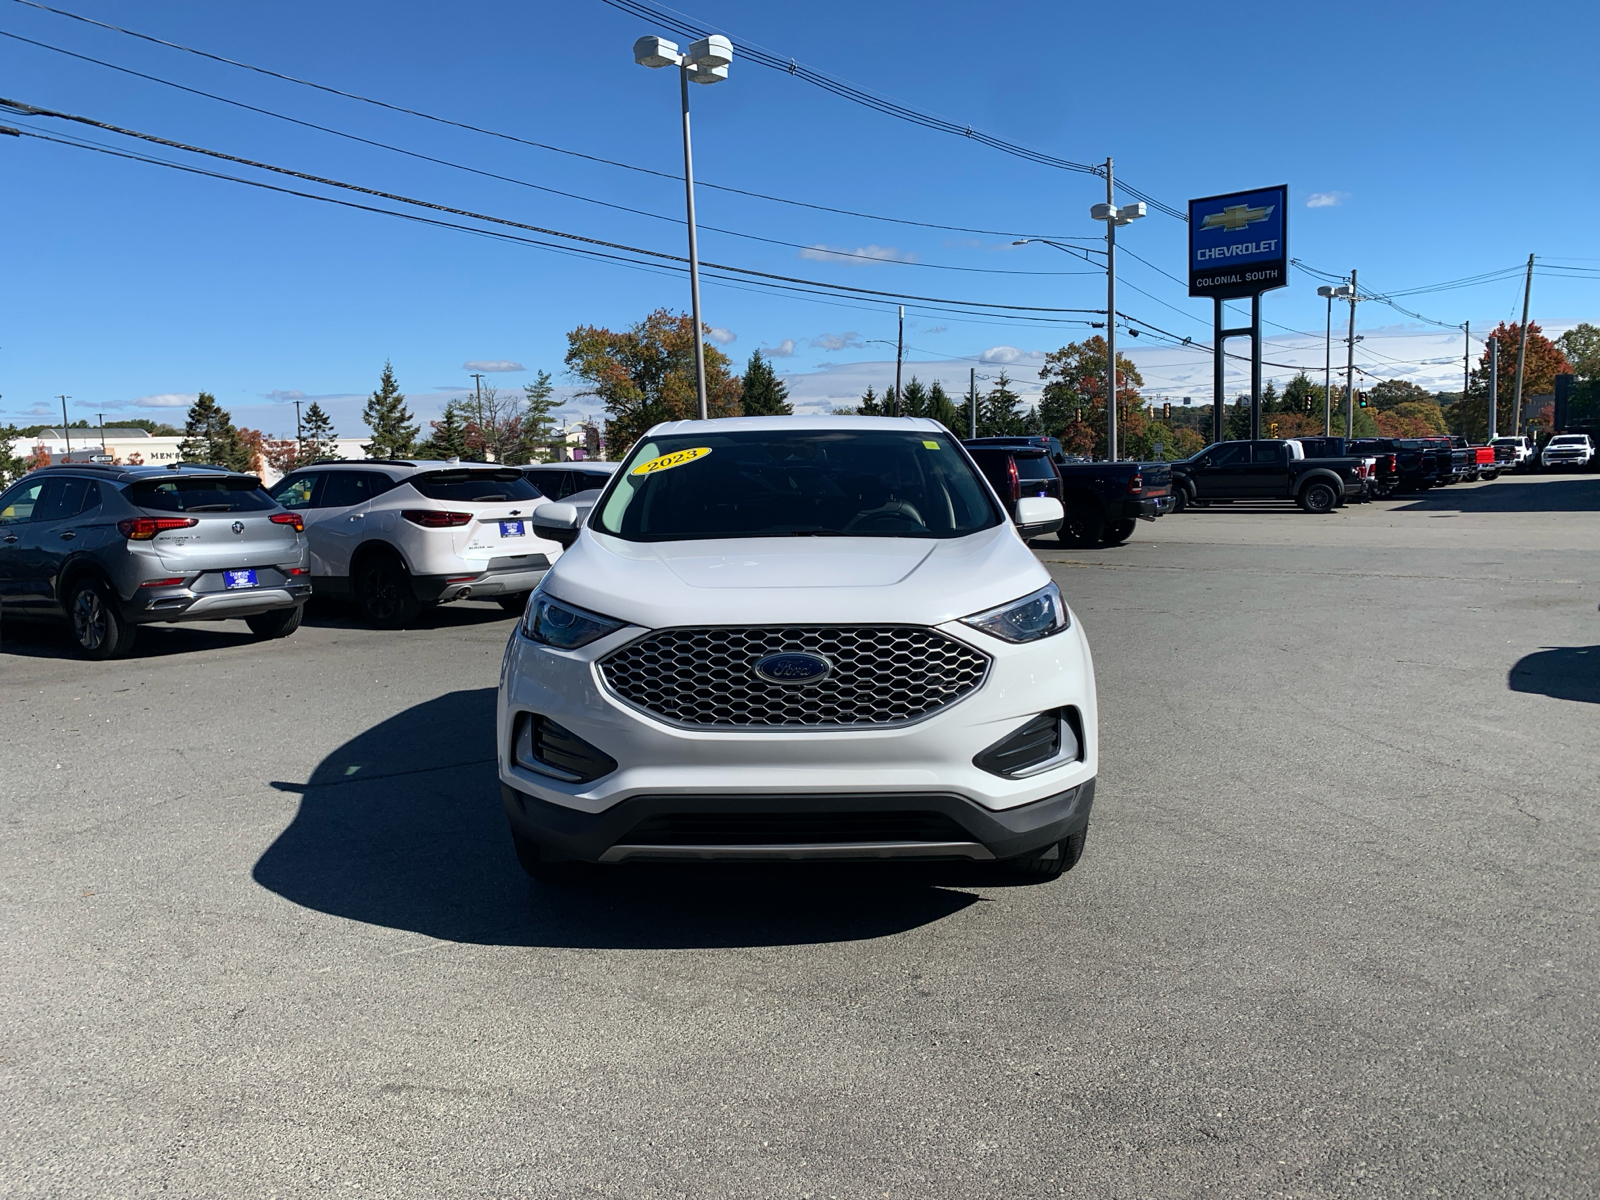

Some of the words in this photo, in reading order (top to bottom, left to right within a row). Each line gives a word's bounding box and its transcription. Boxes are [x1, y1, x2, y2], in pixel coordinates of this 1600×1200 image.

[1197, 239, 1278, 261] CHEVROLET
[1196, 274, 1243, 287] COLONIAL
[1245, 269, 1278, 281] SOUTH
[647, 450, 698, 472] 2023
[773, 660, 813, 676] Ford
